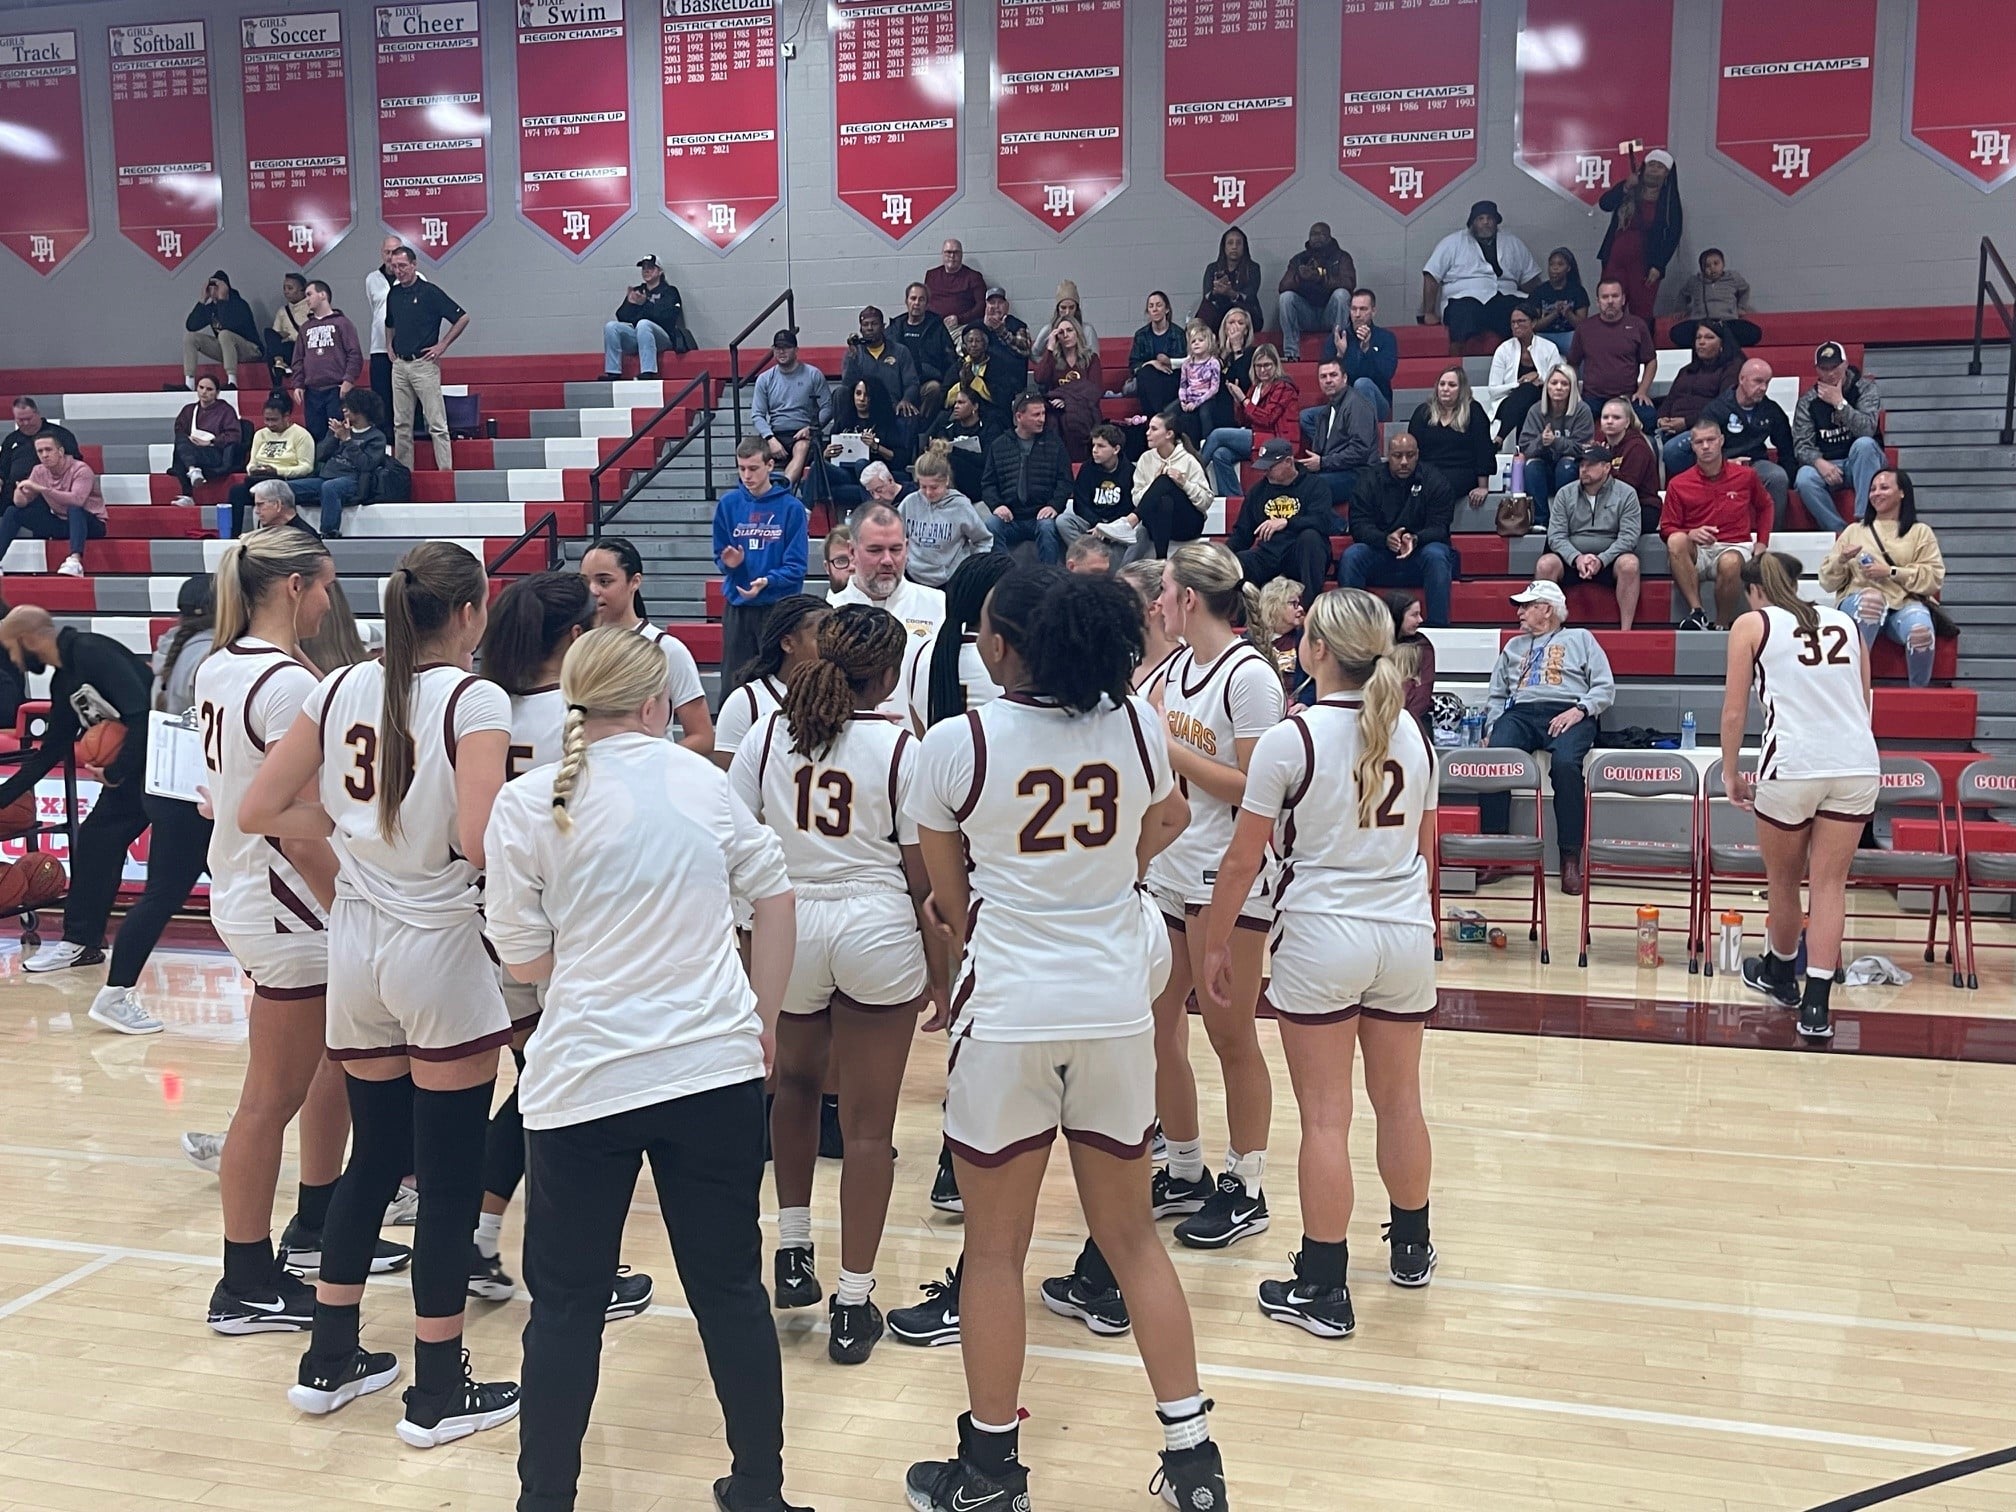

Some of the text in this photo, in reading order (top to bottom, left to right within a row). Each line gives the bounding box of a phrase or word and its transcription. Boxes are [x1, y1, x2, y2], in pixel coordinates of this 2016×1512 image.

[395, 7, 421, 17] DIXIE
[682, 0, 770, 13] Basketball
[841, 2, 951, 17] DISTRICT CHAMPS
[548, 6, 606, 24] Swim
[260, 18, 287, 28] GIRLS
[404, 16, 464, 34] Cheer
[666, 17, 770, 32] DISTRICT CHAMPS
[1000, 17, 1044, 28] 2014 2020
[1168, 20, 1293, 37] 2013 2014 2015 2017 2021
[127, 28, 153, 37] GIRLS
[271, 28, 326, 44] Soccer
[524, 28, 617, 42] REGION CHAMPS
[839, 24, 953, 40] 1962 1963 1968 1972 1973
[134, 32, 195, 53] Softball
[383, 39, 473, 52] REGION CHAMPS
[1168, 38, 1187, 48] 2022
[13, 43, 60, 62] Track
[246, 50, 339, 62] DISTRICT CHAMPS
[114, 58, 204, 70] DISTRICT CHAMPS
[664, 58, 774, 74] 2013 2015 2016 2017 2018
[1731, 58, 1862, 77] REGION CHAMPS
[30, 67, 72, 76] CHAMPS
[664, 72, 727, 84] 2019 2020 2021
[1007, 68, 1113, 82] REGION CHAMPS
[1000, 83, 1069, 95] 1981 1984 2014
[1350, 86, 1467, 102] REGION CHAMPS
[383, 94, 477, 107] STATE RUNNER UP
[1174, 98, 1286, 113] REGION CHAMPS
[1344, 98, 1475, 115] 1983 1984 1986 1987 1993
[380, 110, 396, 118] 2015
[524, 112, 622, 126] STATE RUNNER UP
[1168, 113, 1239, 126] 1991 1993 2001
[524, 126, 580, 137] 1974 1976 2018
[846, 120, 948, 133] REGION CHAMPS
[672, 132, 769, 144] REGION CHAMPS
[840, 134, 905, 146] 1947 1957 2011
[1004, 128, 1116, 143] STATE RUNNER UP
[1346, 129, 1471, 145] STATE RUNNER UP
[391, 140, 473, 151] STATE CHAMPS
[667, 145, 730, 157] 1980 1992 2021
[1000, 146, 1018, 155] 2014
[1343, 148, 1361, 158] 1987
[123, 164, 207, 174] REGION CHAMPS
[255, 158, 341, 168] REGION CHAMPS
[312, 169, 327, 177] 1992
[533, 169, 617, 181] STATE CHAMPS
[291, 179, 305, 187] 2011
[385, 175, 481, 187] NATIONAL CHAMPS
[384, 188, 441, 198] 2005 2006 2017
[524, 184, 539, 192] 1975
[1093, 486, 1121, 505] JAGS
[1793, 624, 1851, 666] 32
[201, 700, 224, 774] 21
[344, 723, 415, 802] 3
[1449, 761, 1525, 778] COLONELS
[1603, 765, 1682, 782] COLONELS
[794, 763, 854, 839] 13
[1016, 760, 1121, 857] 23
